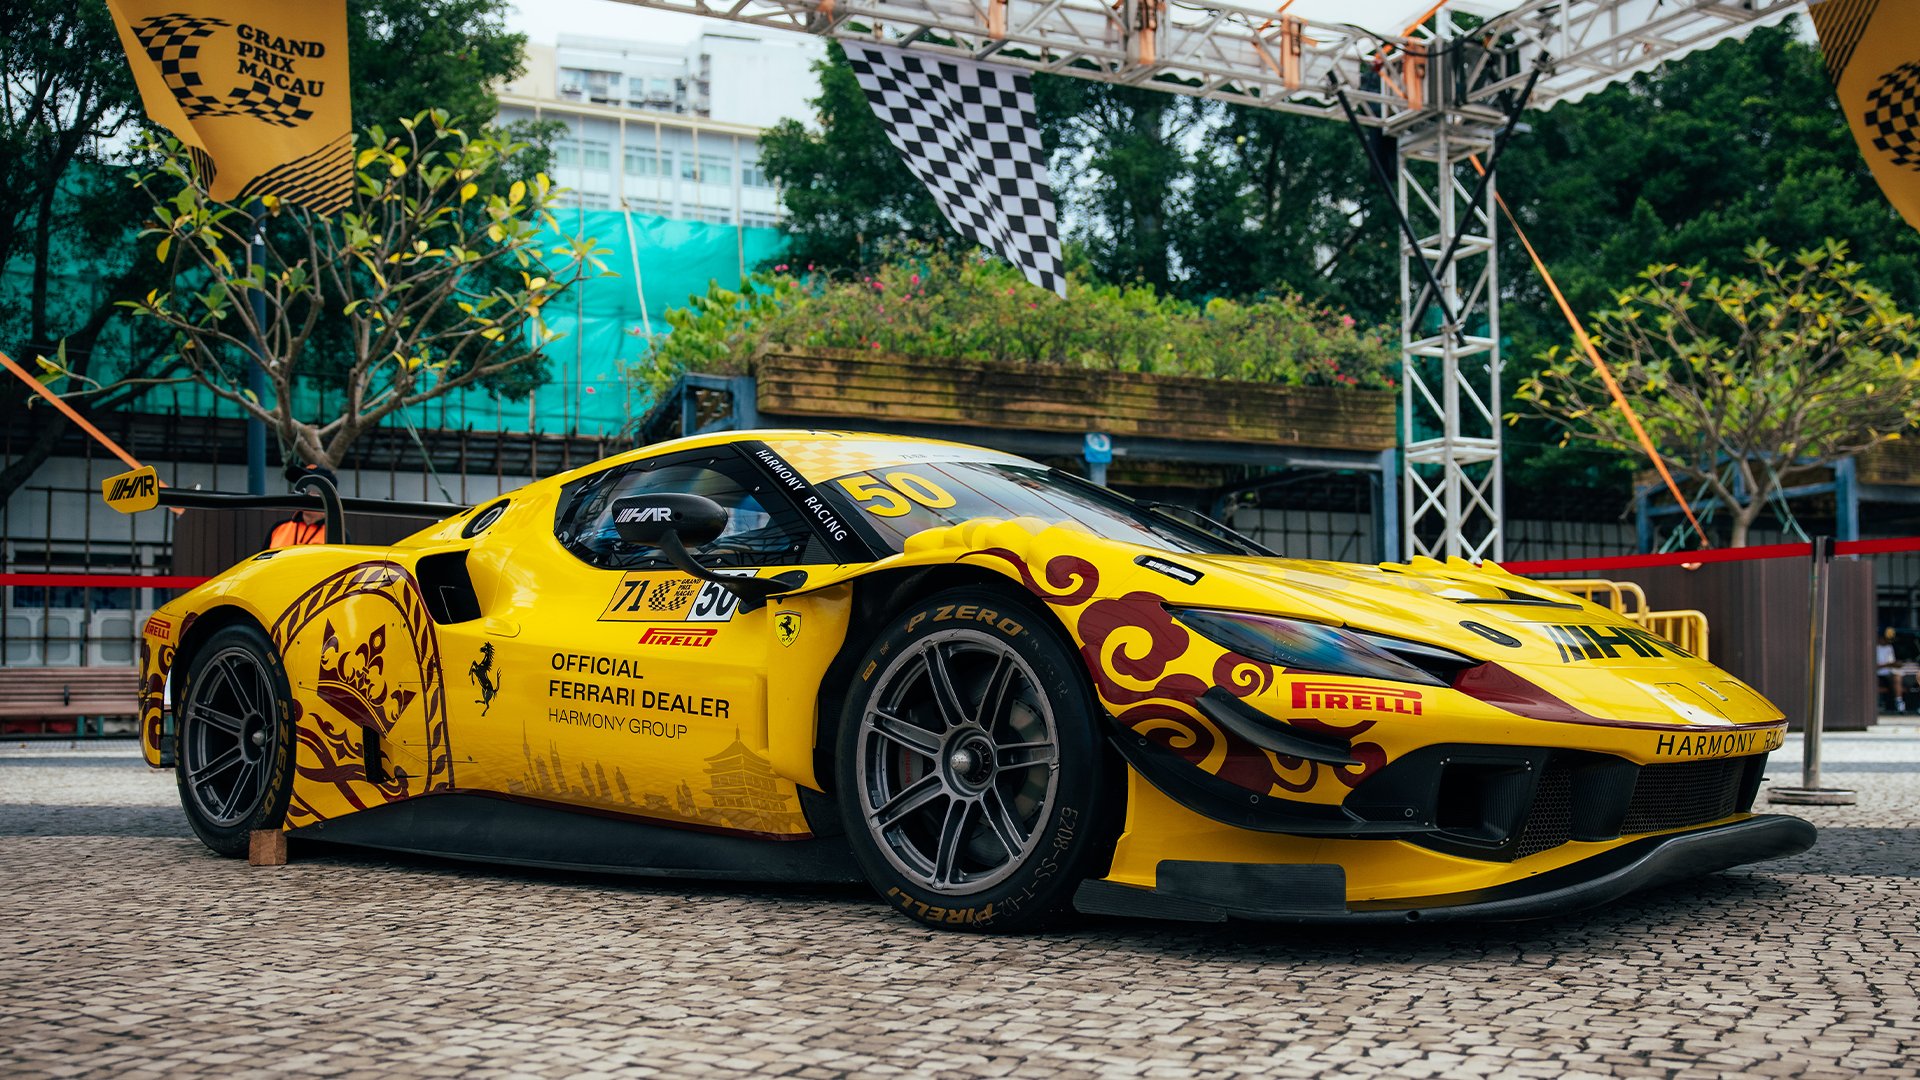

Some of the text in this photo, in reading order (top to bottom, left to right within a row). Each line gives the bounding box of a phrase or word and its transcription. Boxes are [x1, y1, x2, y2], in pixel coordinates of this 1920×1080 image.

[236, 23, 325, 58] GRAND
[237, 40, 295, 74] PRIX
[237, 58, 325, 97] MACAU
[755, 449, 847, 542] HARMONY RACING
[836, 471, 957, 518] 50
[611, 580, 650, 612] 71
[145, 616, 172, 640] PIRELLI
[638, 627, 719, 648] PIRELLI
[904, 604, 1025, 638] P ZERO
[551, 652, 644, 680] OFFICIAL
[549, 679, 731, 719] FERRARI DEALER
[1291, 682, 1423, 716] PIRELLI
[549, 707, 688, 740] HARMONY GROUP
[1656, 732, 1757, 756] HARMONY
[887, 886, 994, 924] PIRELLI
